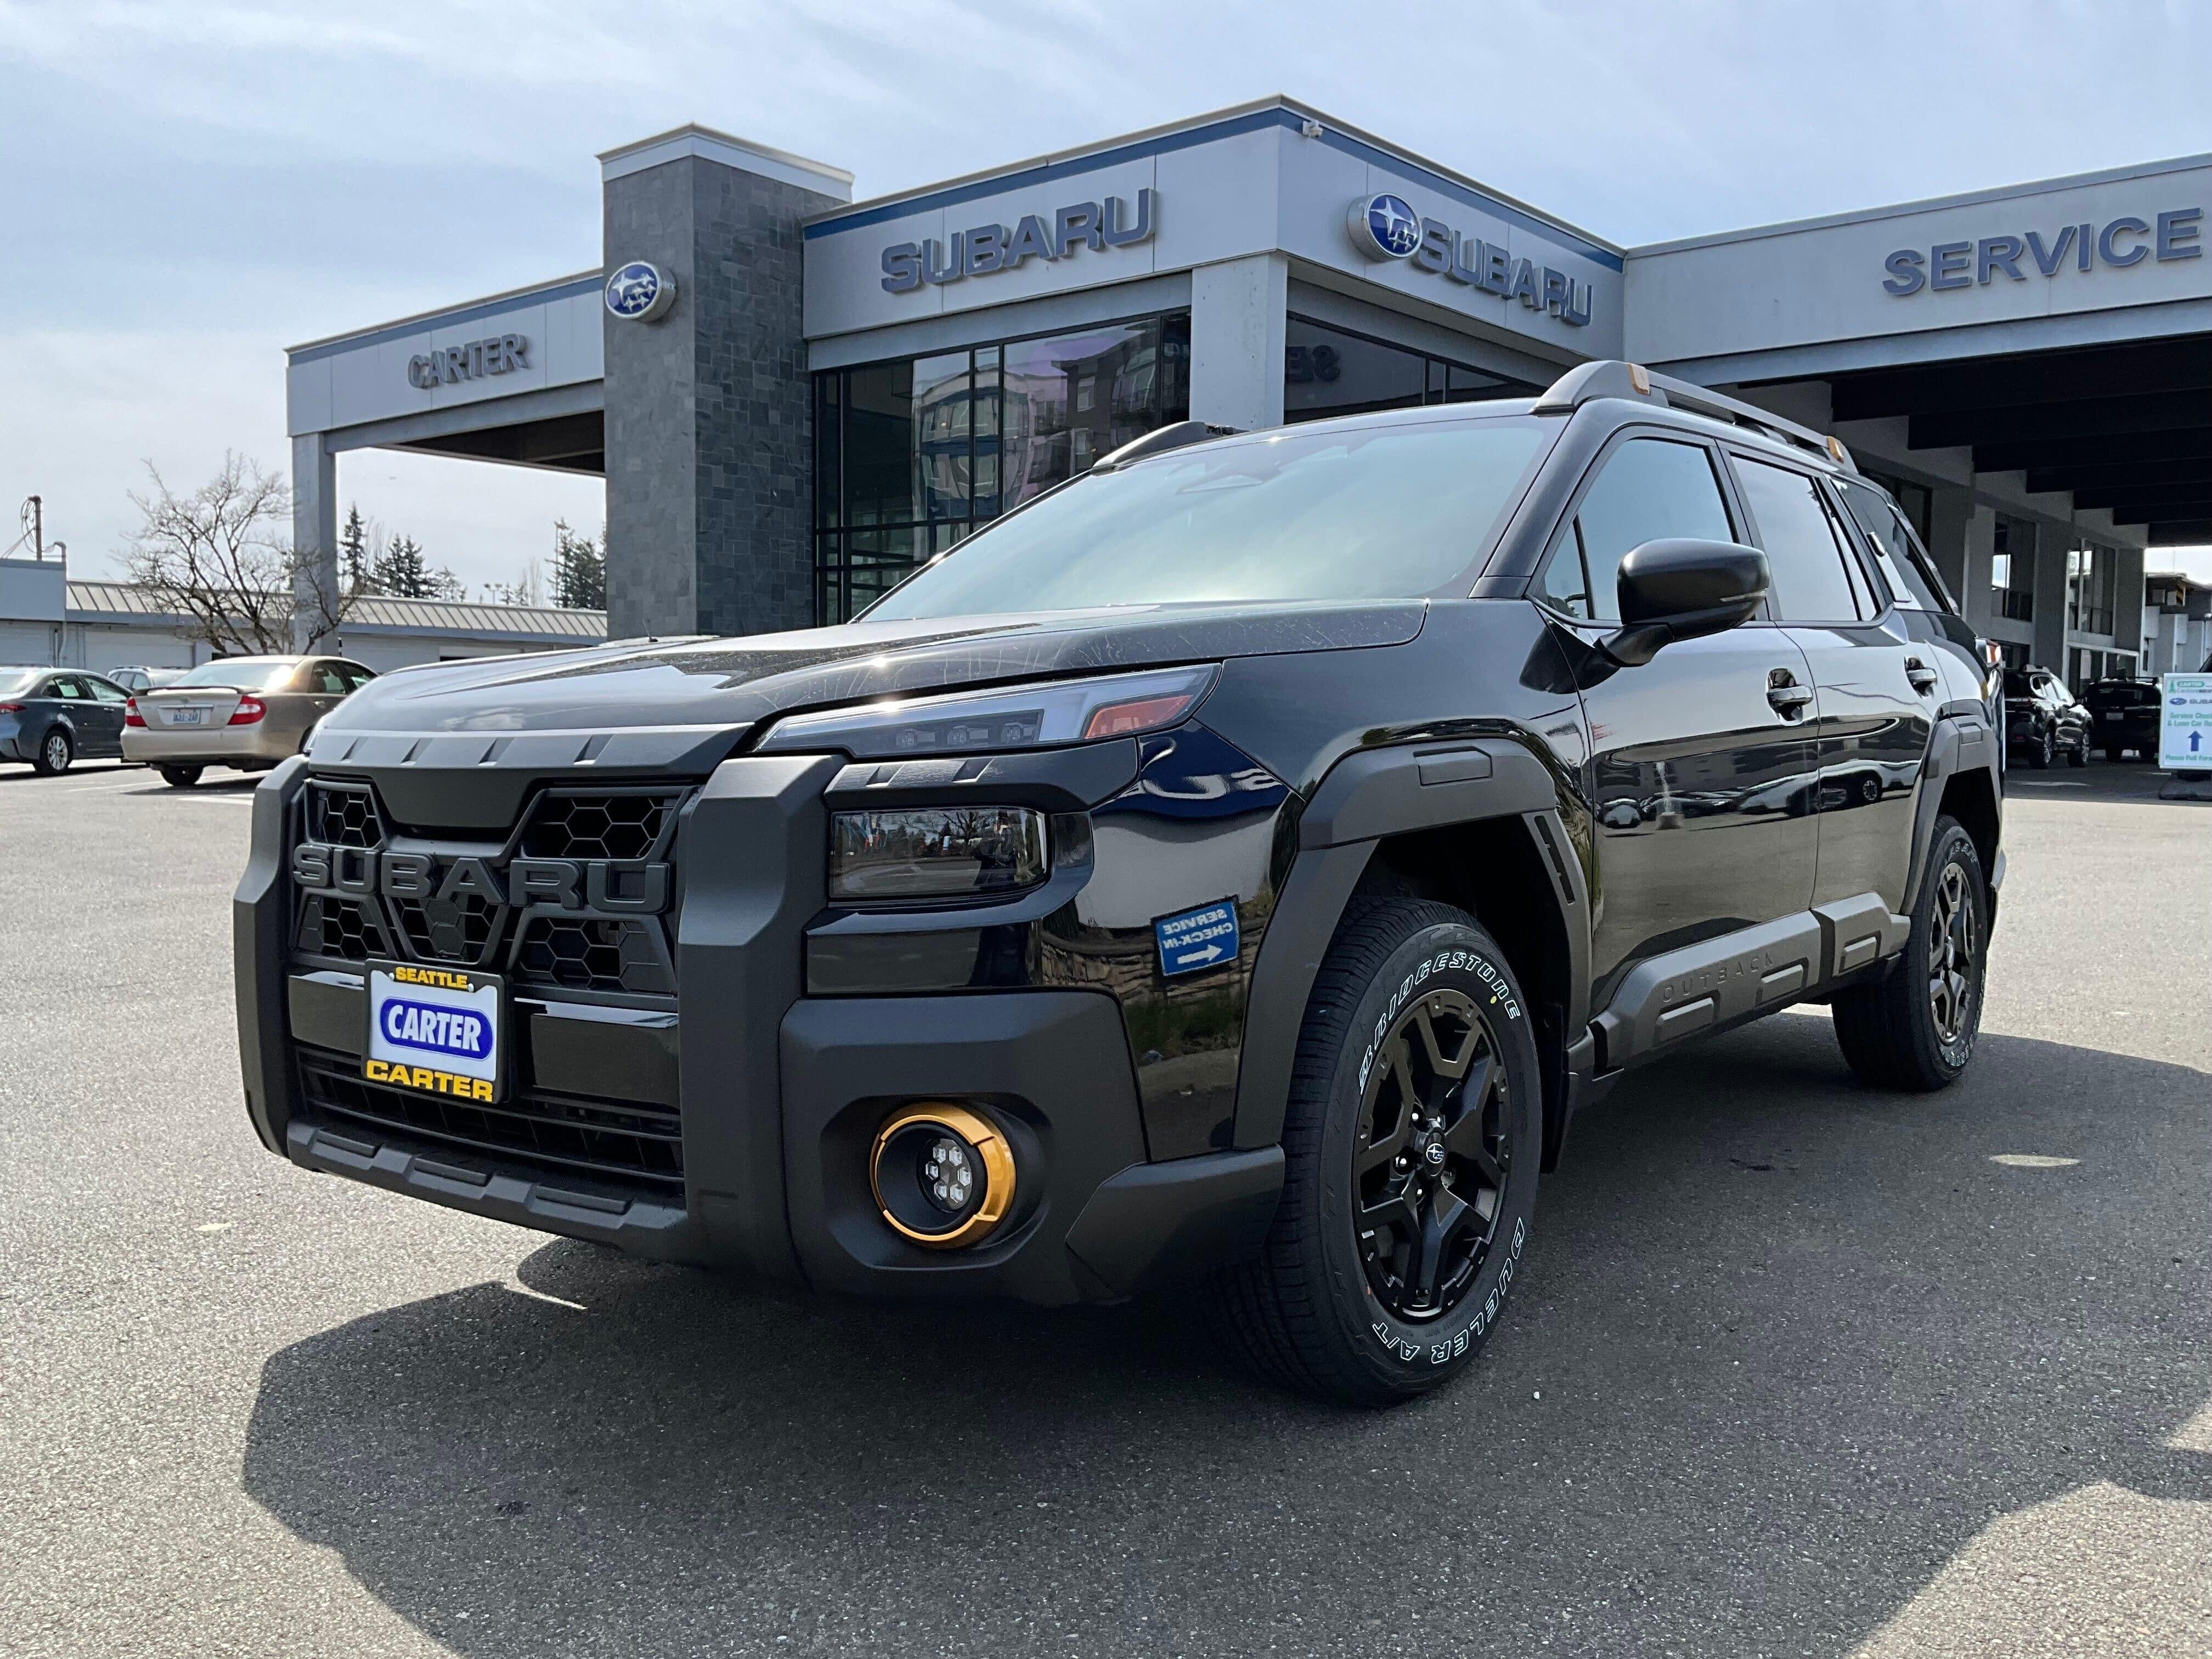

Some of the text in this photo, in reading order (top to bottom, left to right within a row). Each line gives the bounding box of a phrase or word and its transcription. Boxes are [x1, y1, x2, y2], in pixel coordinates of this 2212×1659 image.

[881, 188, 1156, 294] SUBARU
[1414, 217, 1592, 326] SUBARU
[1882, 207, 2203, 296] SERVICE
[408, 333, 530, 390] CARTER
[293, 844, 670, 914] SUBARU
[395, 967, 468, 989] SEATTLE
[1662, 952, 1773, 1002] OUTBACK
[387, 1003, 482, 1052] CARTER
[1359, 952, 1520, 1095] BRIDGESTONE
[366, 1059, 493, 1103] CARTER
[1372, 1217, 1525, 1364] DUELER A/T
